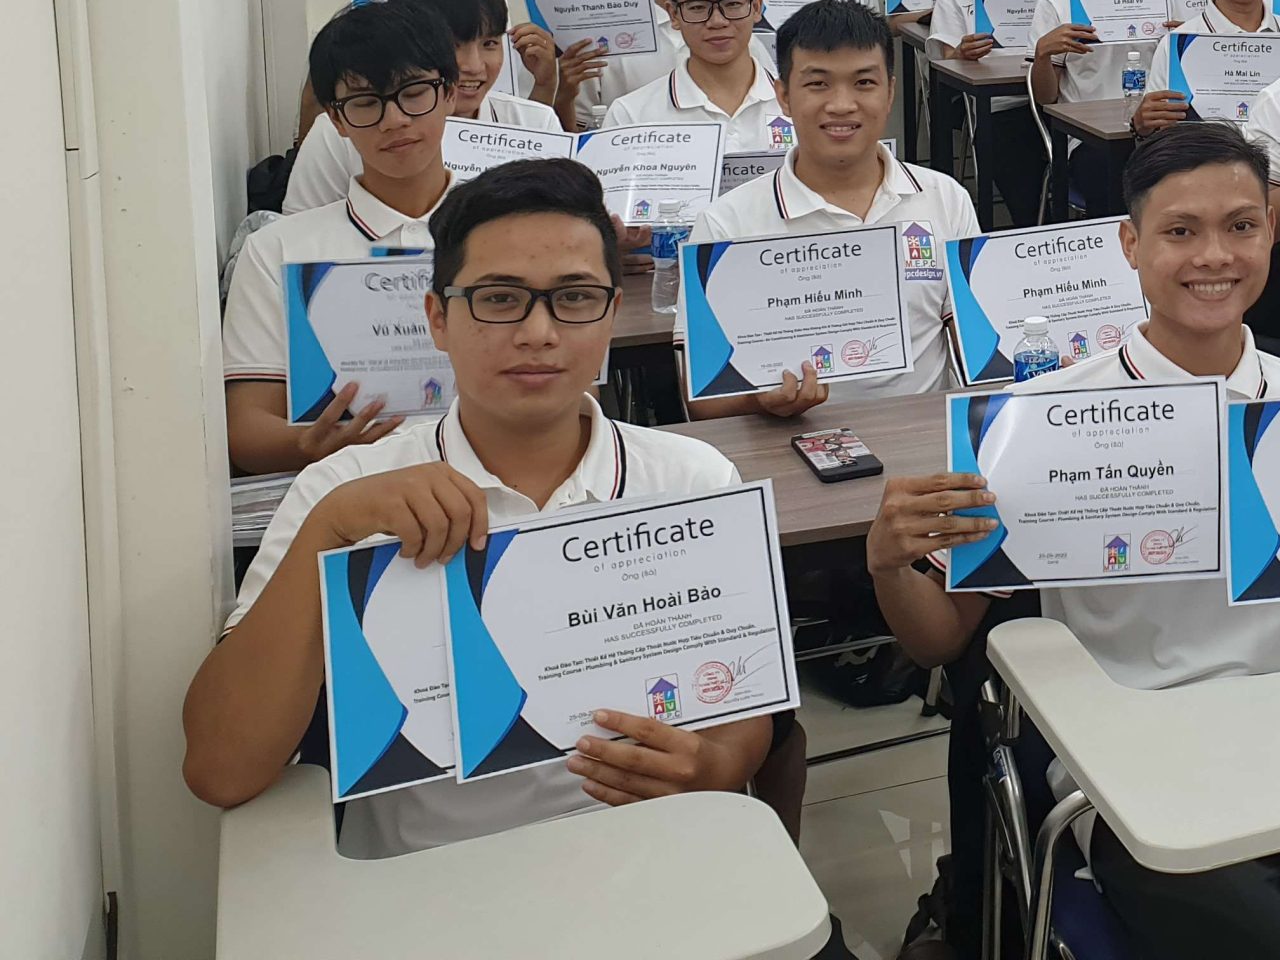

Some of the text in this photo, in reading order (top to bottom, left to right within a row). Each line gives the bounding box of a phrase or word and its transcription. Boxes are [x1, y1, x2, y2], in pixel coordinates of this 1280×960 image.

[1213, 40, 1273, 54] Certificate
[458, 129, 543, 151] Certificate
[611, 130, 691, 147] Certificate
[596, 164, 631, 177] Nguyễn
[633, 163, 659, 172] Khoa
[759, 243, 862, 266] Certificate
[1014, 235, 1104, 259] Certificate
[767, 288, 863, 309] Phạm Hiếu Minh
[1023, 278, 1107, 299] Phạm Hiếu Minh
[1047, 399, 1175, 426] Certificate
[1086, 427, 1150, 438] appreciation
[1049, 460, 1174, 484] Phạm Tấn Quyền
[1089, 492, 1135, 501] SUCCESSFULLY
[562, 517, 714, 563] Certificate
[611, 548, 687, 571] appreciation
[622, 571, 639, 583] Ông
[568, 585, 721, 628] Bùi Văn Hoài Bảo
[621, 614, 722, 641] SUCCESSFULLY COMPLETED
[538, 634, 742, 681] Training Course Plumbing Sanitary System Comply Standard
